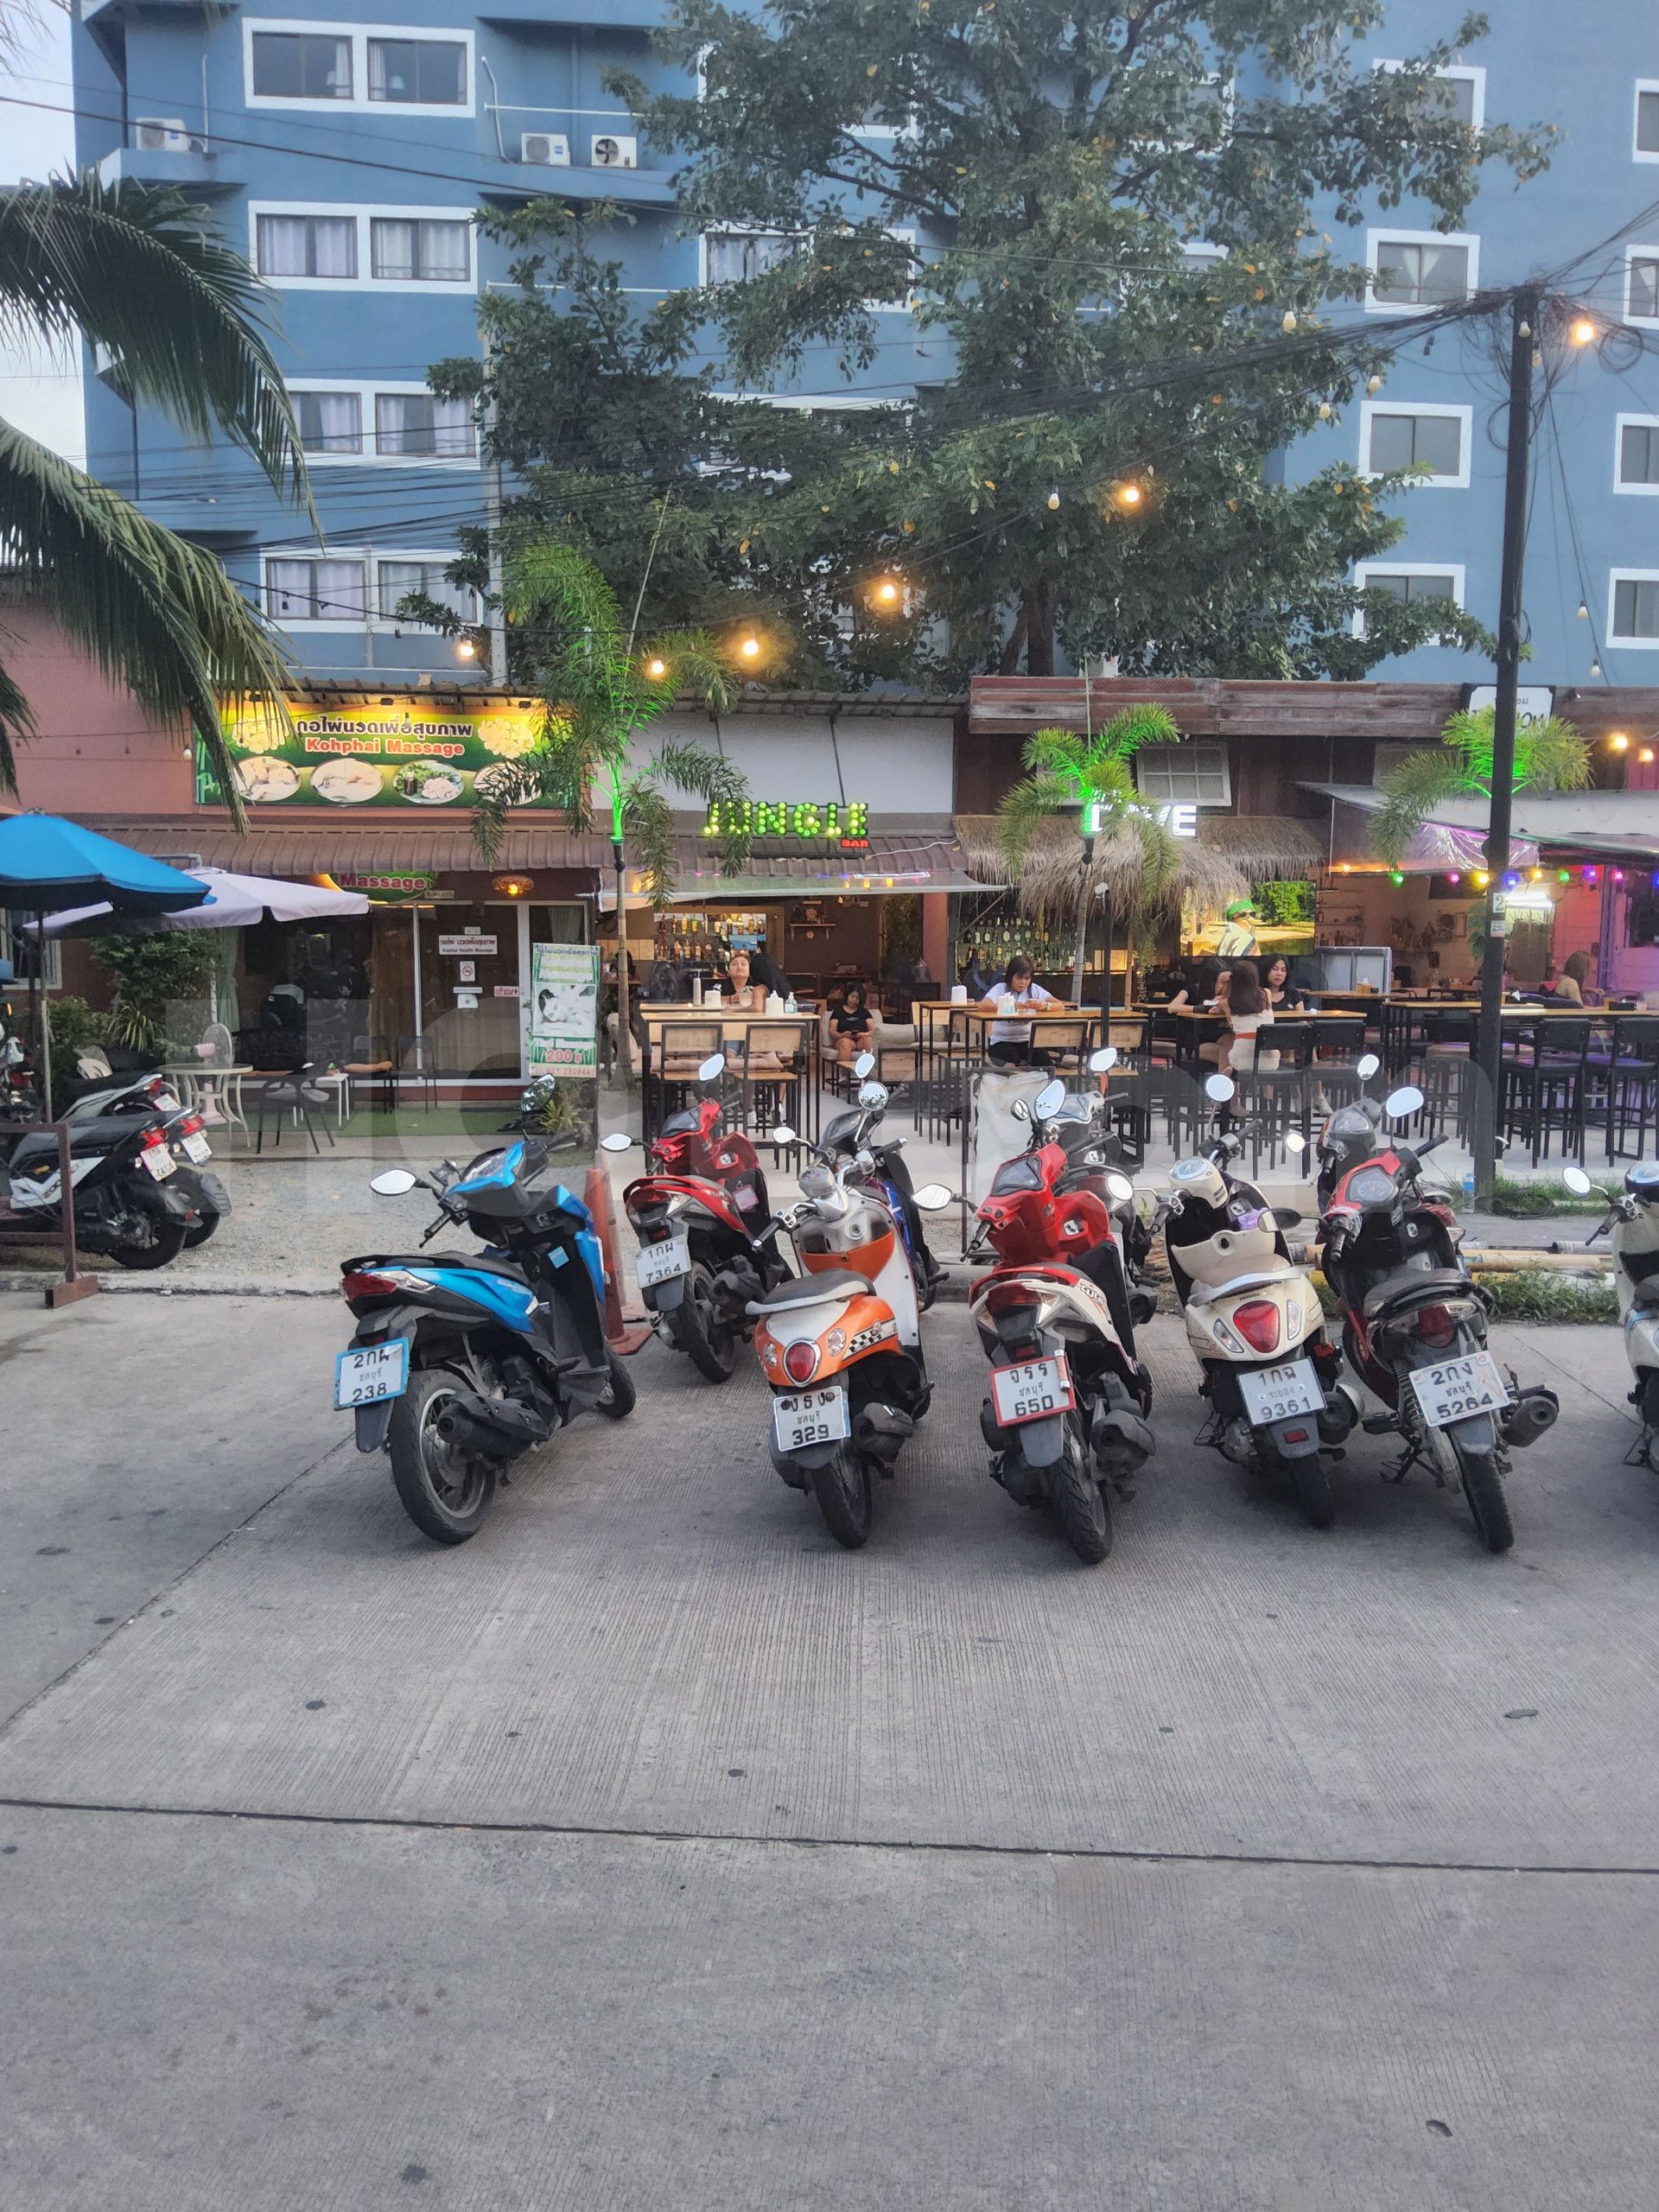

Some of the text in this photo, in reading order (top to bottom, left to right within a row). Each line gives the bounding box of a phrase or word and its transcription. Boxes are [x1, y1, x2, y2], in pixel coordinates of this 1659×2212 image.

[306, 738, 465, 758] Kohphai Massage
[841, 838, 869, 849] BAR
[340, 871, 427, 893] Massage
[1496, 895, 1503, 911] 2
[546, 1048, 573, 1063] 200
[353, 1382, 387, 1402] 238
[1019, 1381, 1045, 1397] ชลบุรี
[1446, 1381, 1472, 1397] ชลบุรี
[1014, 1395, 1054, 1417] 650
[1261, 1395, 1312, 1421] 9361
[1436, 1392, 1493, 1419] 5264
[791, 1424, 830, 1446] 329
